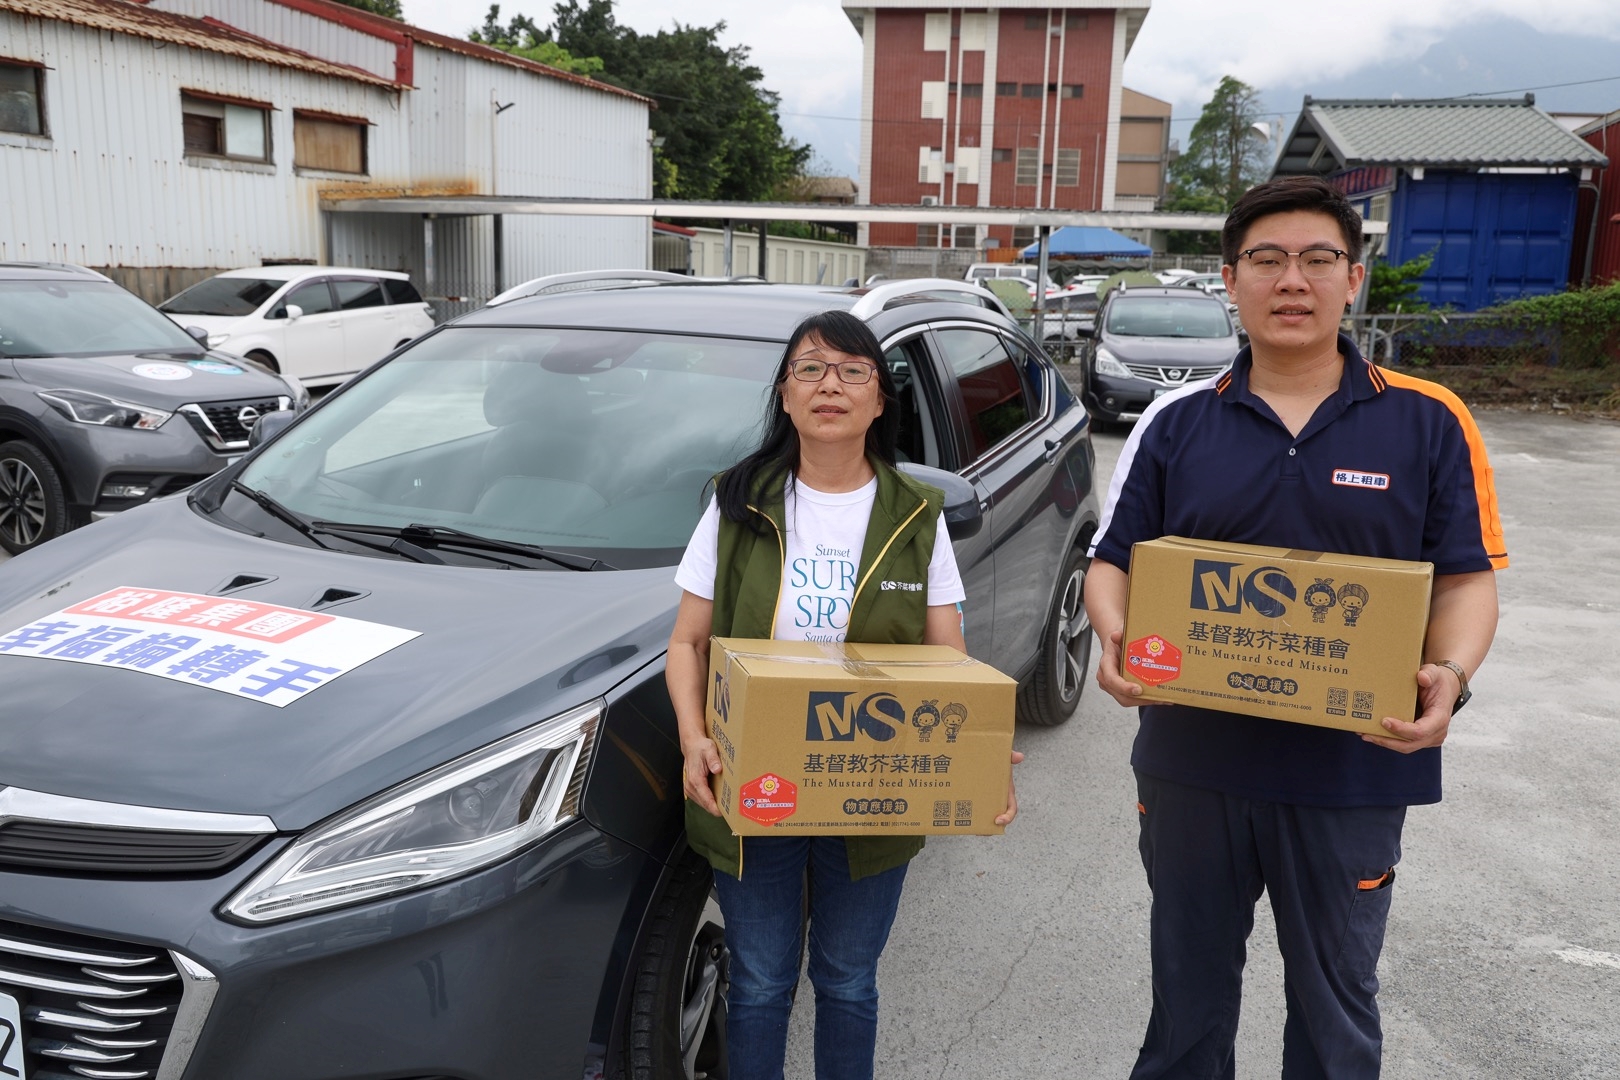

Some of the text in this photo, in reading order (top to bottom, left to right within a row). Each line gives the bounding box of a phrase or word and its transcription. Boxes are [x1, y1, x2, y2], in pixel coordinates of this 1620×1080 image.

[1335, 472, 1387, 487] 格上租車
[815, 544, 851, 558] Sunset
[81, 590, 306, 638] 裕隆集團
[804, 631, 833, 643] Santa
[1187, 620, 1351, 660] 基督教芥菜種會
[0, 620, 343, 698] 幸福輪轉手
[1187, 644, 1349, 675] The Mustard Seed Mission
[803, 753, 953, 774] 基督教芥菜種會
[803, 777, 951, 788] The Mustard Seed Mission
[845, 801, 907, 814] 物資應援箱
